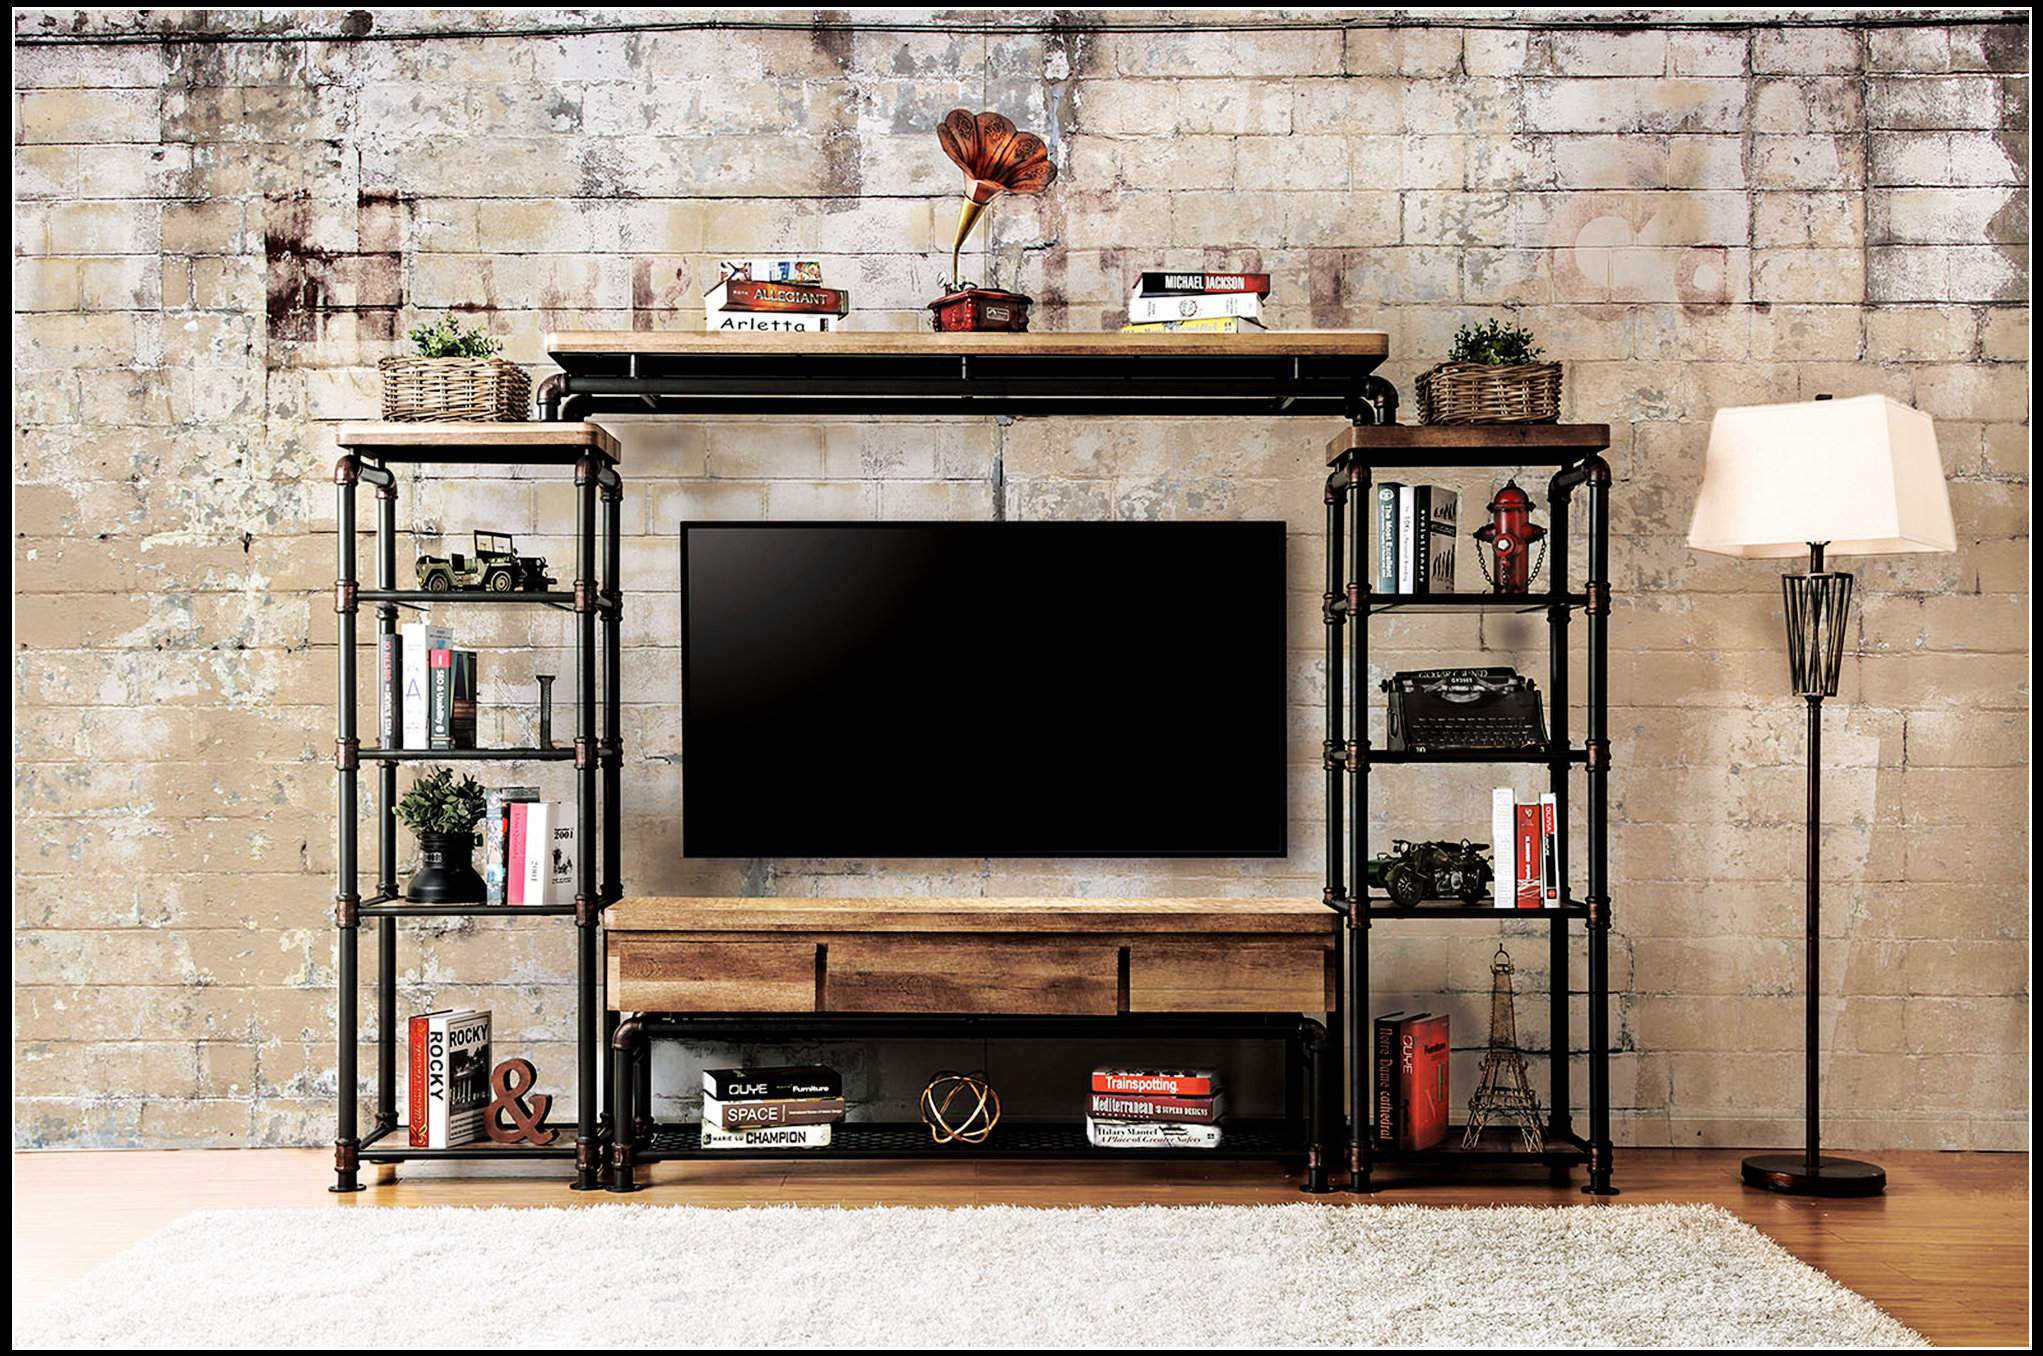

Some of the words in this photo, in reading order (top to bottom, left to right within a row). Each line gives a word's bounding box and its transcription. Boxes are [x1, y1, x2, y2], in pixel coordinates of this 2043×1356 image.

[1165, 275, 1204, 289] MICHAEL
[1205, 276, 1245, 290] JACKSON
[754, 288, 828, 305] ALLEGIANT
[720, 317, 806, 332] Arletta
[1385, 504, 1393, 519] The
[1385, 520, 1393, 540] Most
[1385, 541, 1393, 578] Excellent
[436, 669, 445, 685] SEO
[434, 692, 445, 725] Usability
[384, 718, 392, 736] STAR
[554, 831, 574, 840] 2001
[449, 1023, 489, 1048] ROCKY
[1379, 1028, 1393, 1055] Notre
[430, 1031, 444, 1101] ROCKY
[1379, 1058, 1393, 1088] Dame
[792, 1085, 830, 1093] Furniture
[727, 1106, 778, 1122] SPACE
[1092, 1096, 1154, 1115] Mediterranean
[1162, 1106, 1183, 1115] SUPERB
[1184, 1107, 1208, 1117] DESIGNS
[1379, 1090, 1394, 1140] cathedral
[746, 1131, 807, 1144] CHAMPION
[1098, 1128, 1125, 1136] Hilary
[1127, 1128, 1158, 1136] Mantel
[1177, 1136, 1202, 1144] Safety
